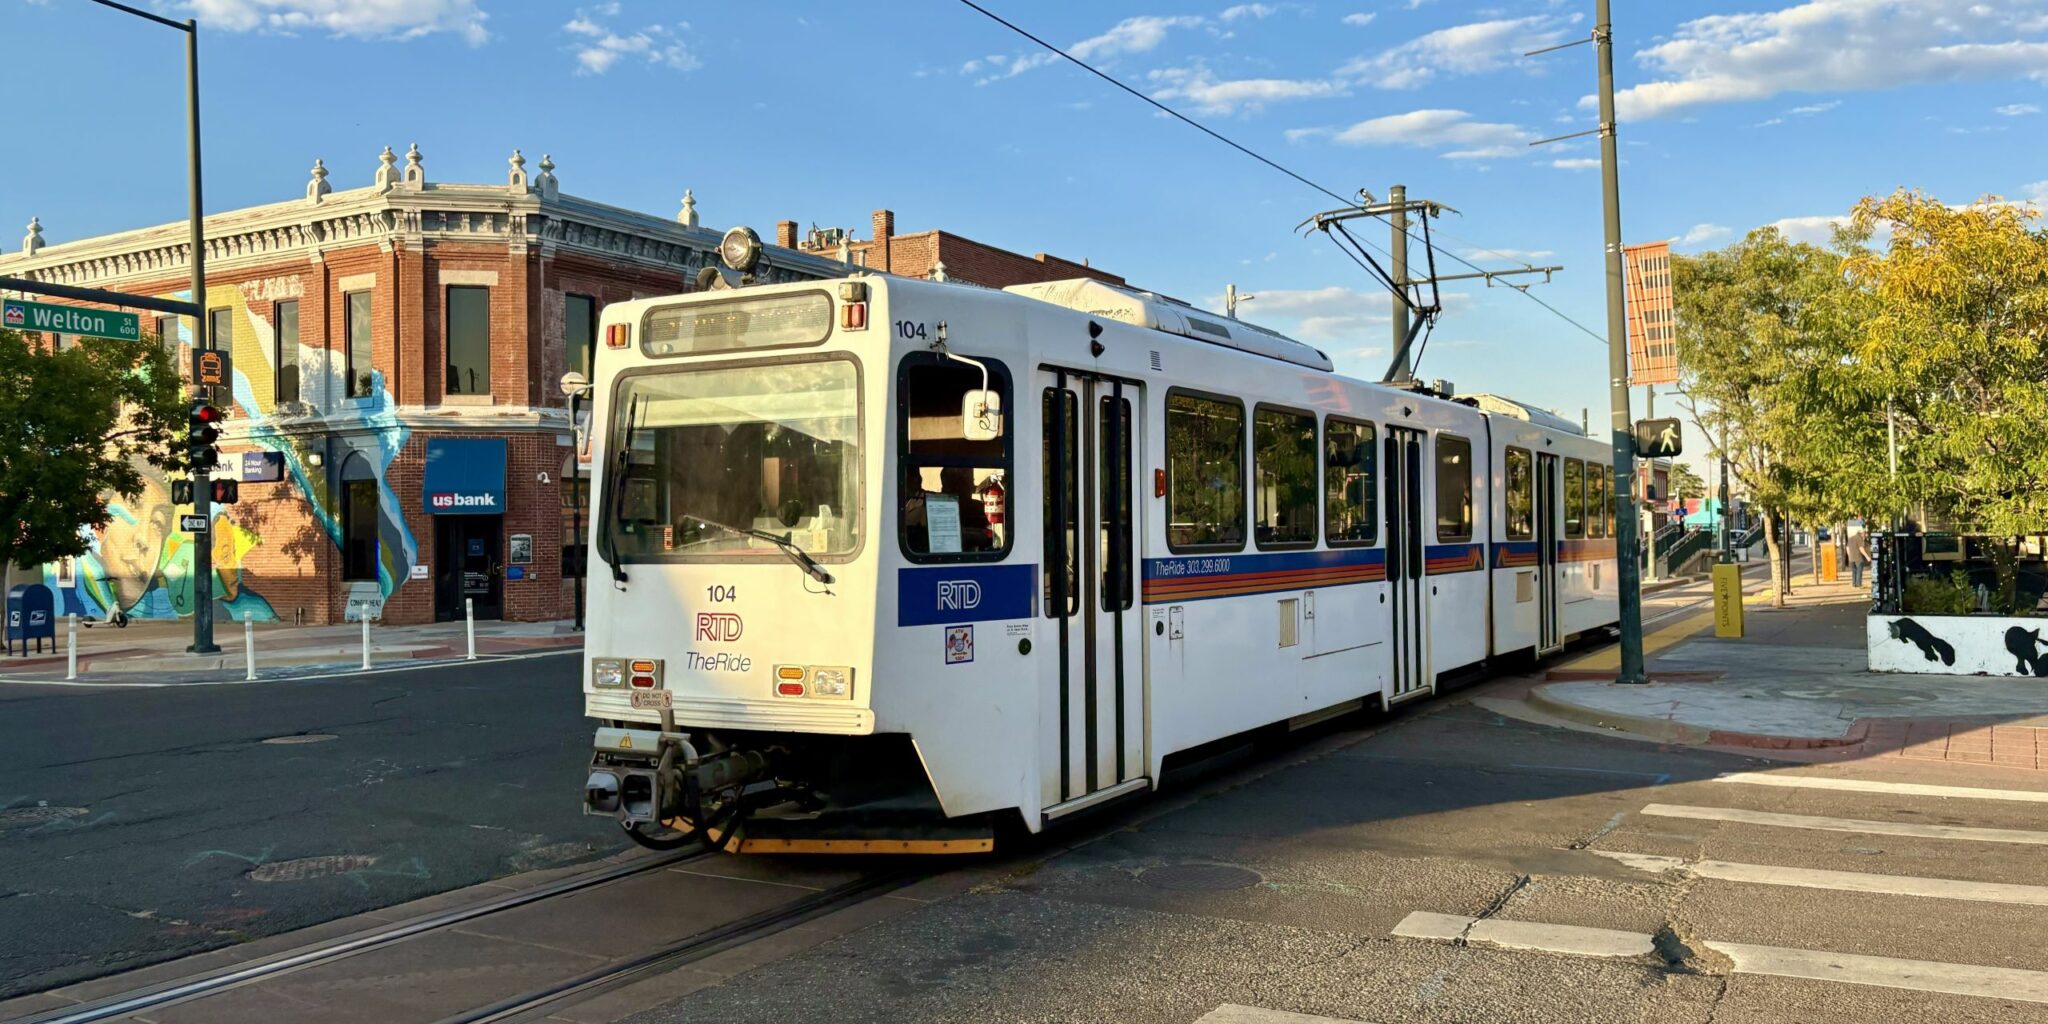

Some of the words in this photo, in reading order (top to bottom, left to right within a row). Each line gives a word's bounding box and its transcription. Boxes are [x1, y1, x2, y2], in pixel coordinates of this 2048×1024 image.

[33, 308, 105, 333] Welton
[123, 318, 132, 326] St
[120, 326, 136, 335] 600
[895, 319, 927, 340] 104
[1155, 560, 1185, 576] TheRide
[1186, 558, 1231, 575] 303.299.6000
[707, 585, 736, 602] 104
[937, 579, 981, 611] RTD
[696, 612, 743, 641] RTD
[686, 651, 751, 672] TheRide
